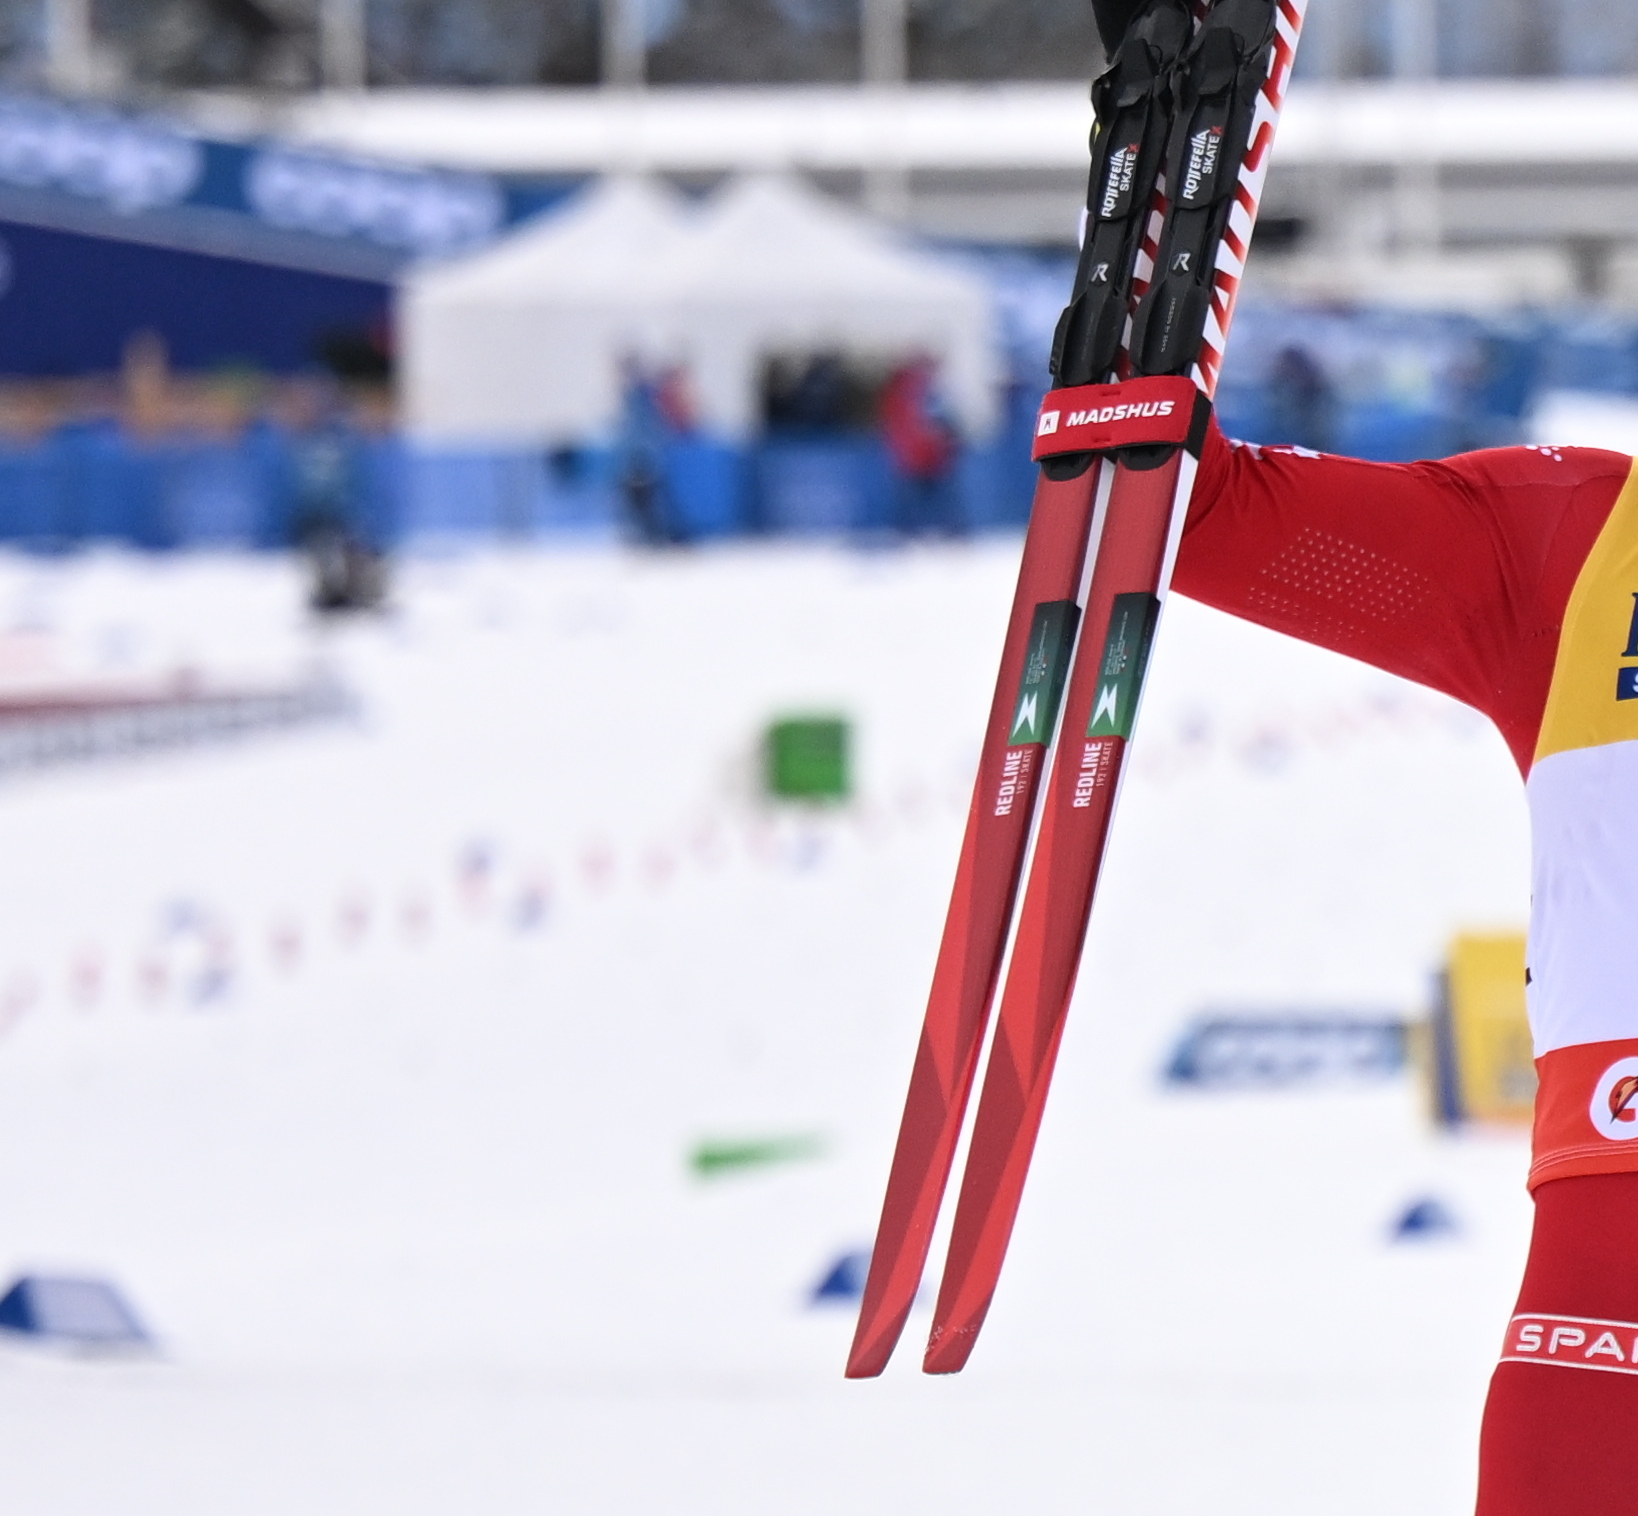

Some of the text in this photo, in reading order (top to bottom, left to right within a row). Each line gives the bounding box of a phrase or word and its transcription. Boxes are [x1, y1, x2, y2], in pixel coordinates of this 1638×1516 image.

[1066, 401, 1174, 427] MADSHUS
[995, 751, 1022, 817] REDLINE
[1074, 743, 1101, 808] REDLINE
